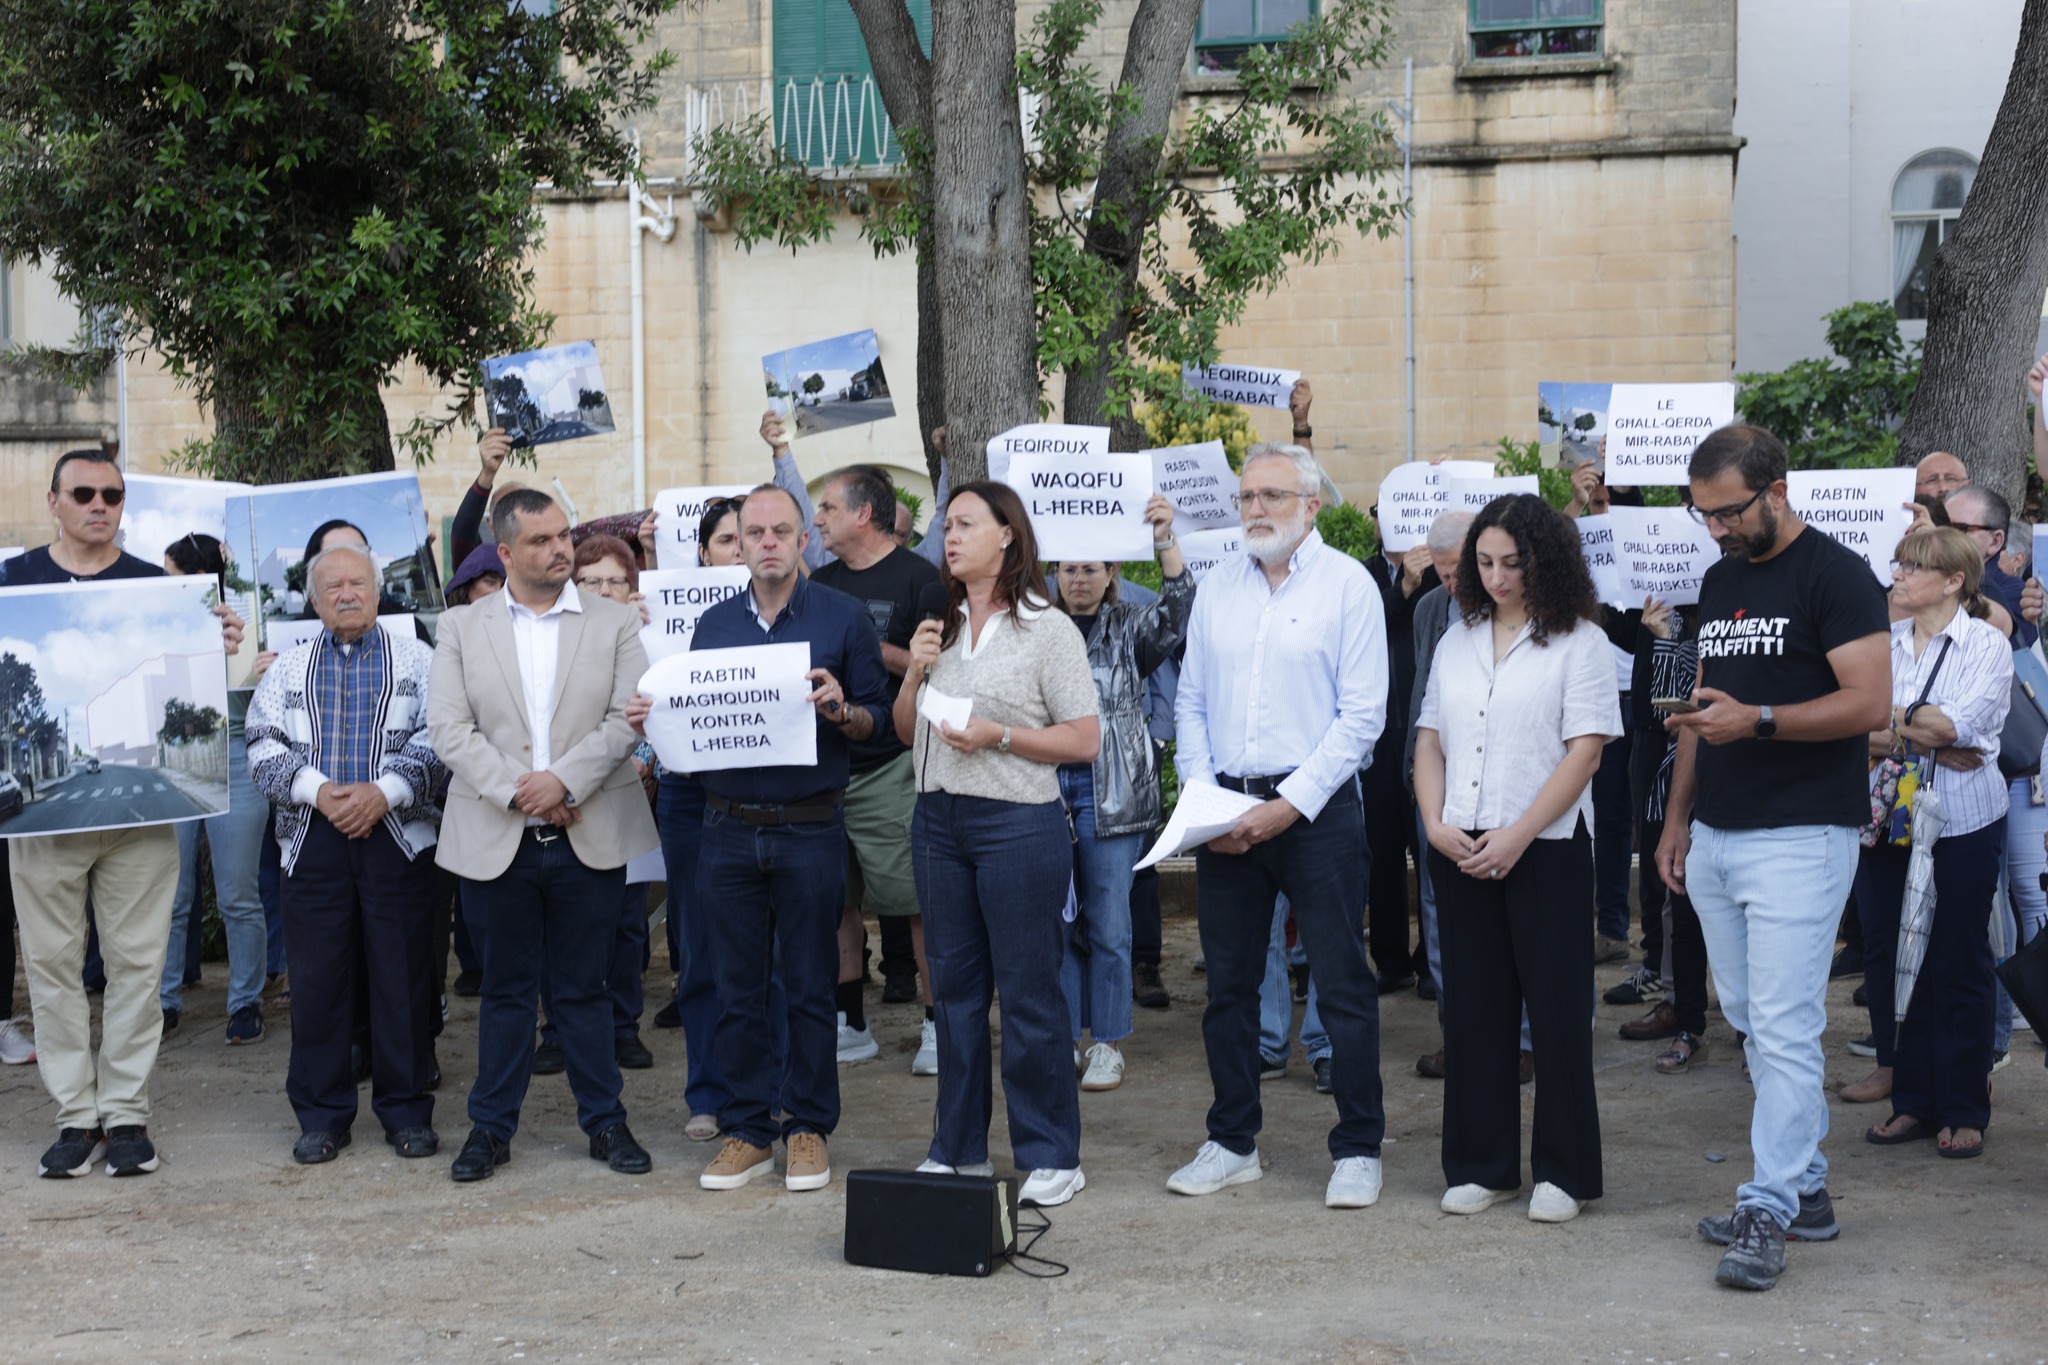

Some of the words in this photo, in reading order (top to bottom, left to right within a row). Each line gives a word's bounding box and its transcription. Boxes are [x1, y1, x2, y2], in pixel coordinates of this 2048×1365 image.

[1657, 399, 1675, 410] LE
[1003, 438, 1090, 455] TEQIRDUX
[1625, 435, 1700, 447] MIR-RABAT
[1164, 459, 1200, 474] RABTIN
[1615, 454, 1692, 466] SAL-BUSKE
[1031, 472, 1123, 489] WAQQFU
[1425, 474, 1440, 486] LE
[1176, 493, 1218, 508] KONTRA
[1811, 487, 1867, 501] RABTIN
[1401, 508, 1448, 518] MIR-RA
[1647, 524, 1660, 536] LE
[1580, 529, 1614, 546] EQIR
[1828, 531, 1870, 544] NTRA
[1224, 540, 1240, 553] LE
[1633, 561, 1692, 574] MIR-RABAT
[659, 585, 743, 606] TEQIRD
[690, 667, 756, 684] RABTIN
[691, 713, 766, 730] KONTRA
